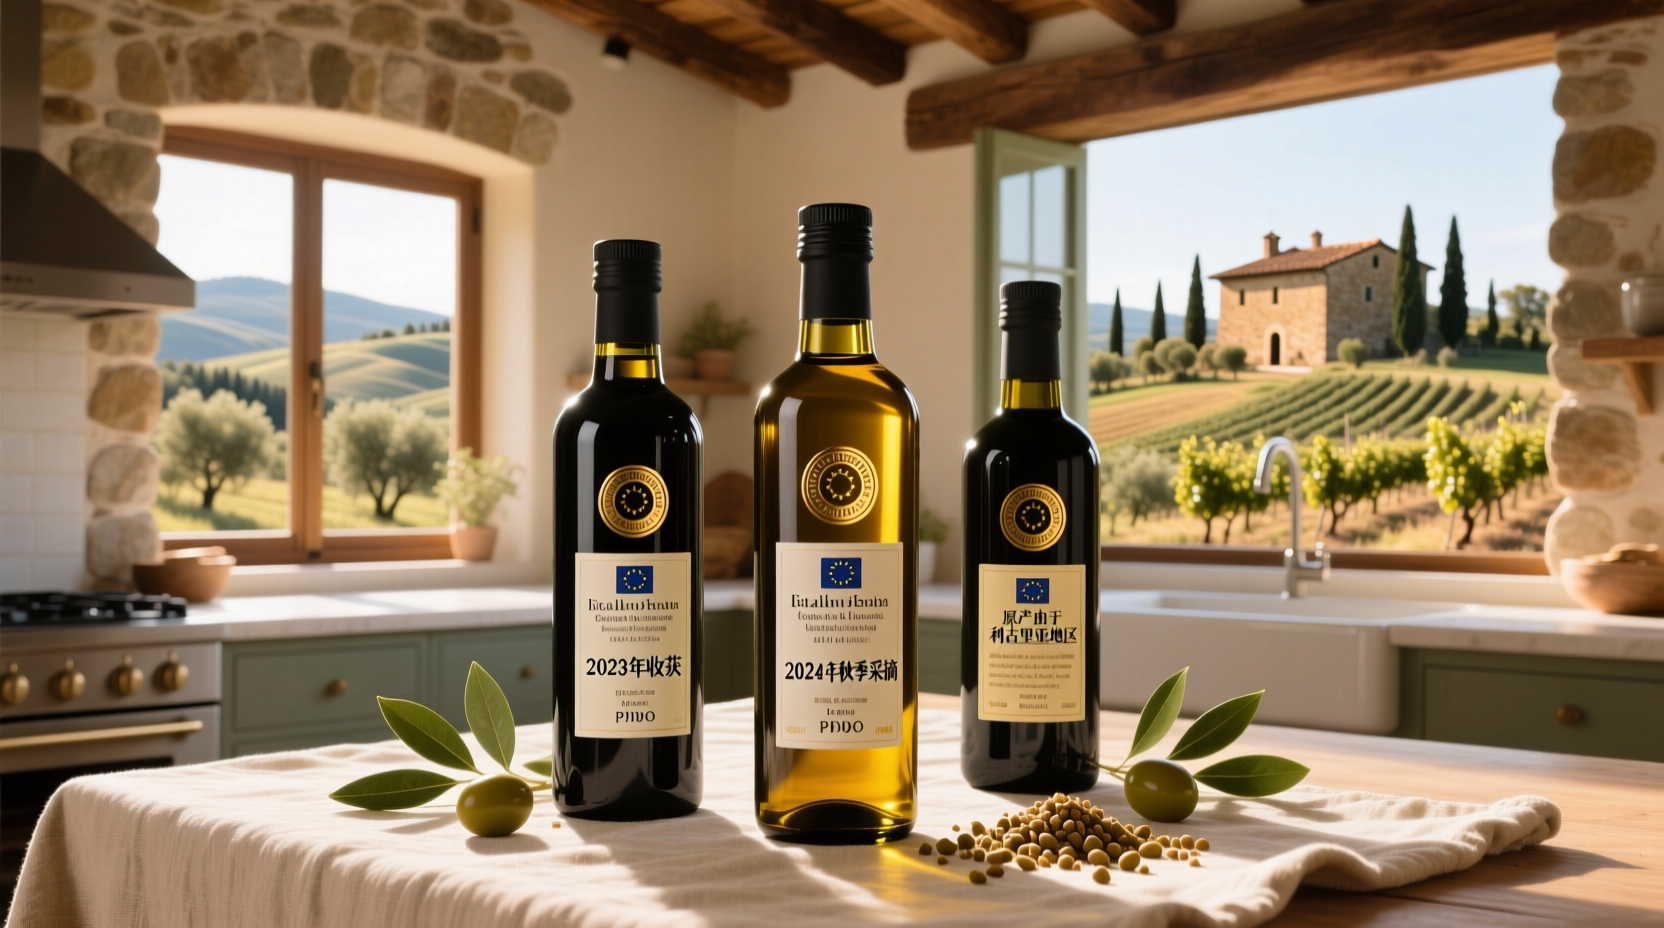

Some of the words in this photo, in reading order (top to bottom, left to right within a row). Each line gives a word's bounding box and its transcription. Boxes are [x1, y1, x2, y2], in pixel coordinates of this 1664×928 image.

[586, 654, 682, 678] 2023年收获
[784, 659, 898, 683] 2024年秋季采摘
